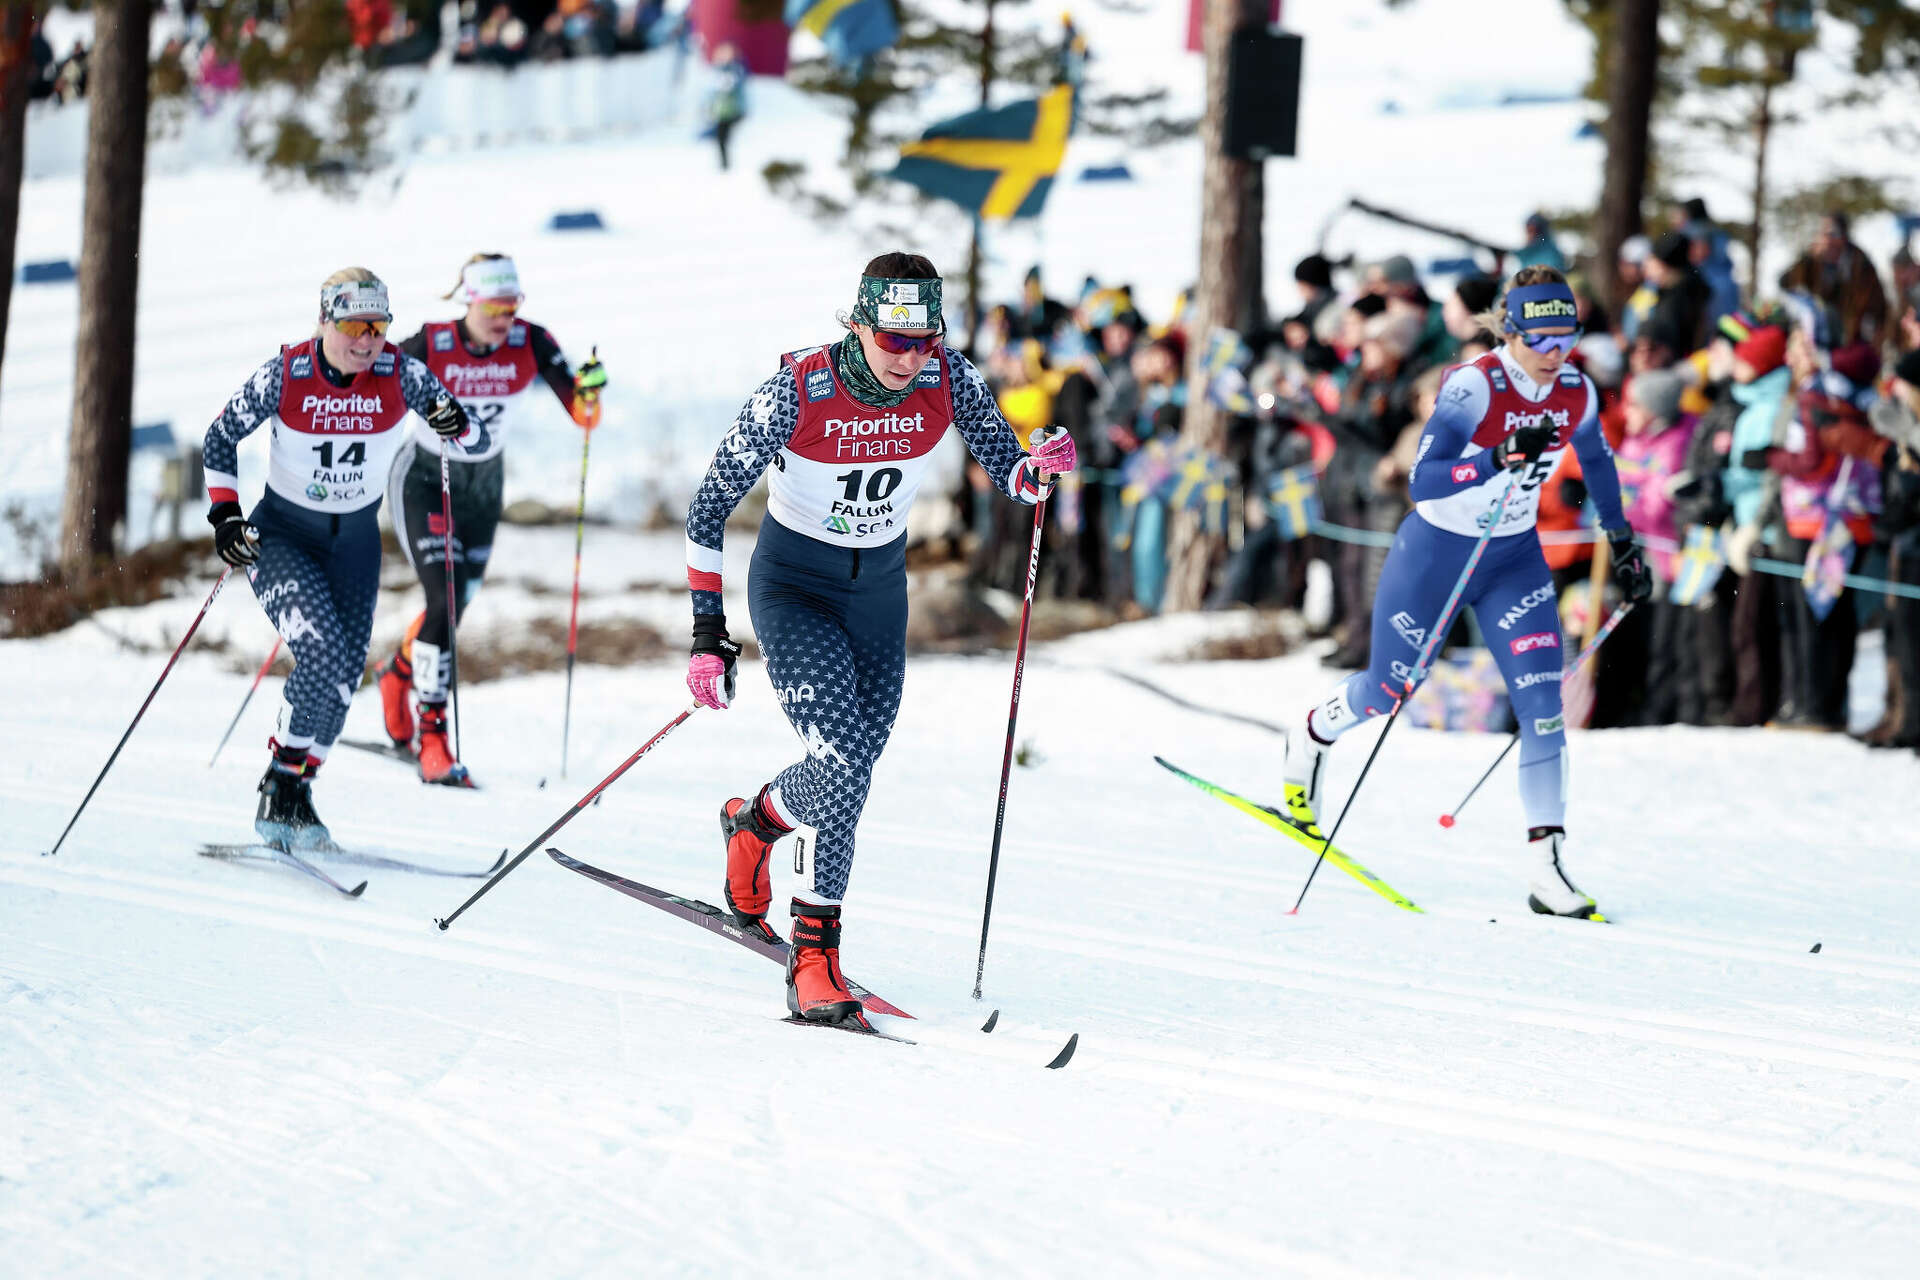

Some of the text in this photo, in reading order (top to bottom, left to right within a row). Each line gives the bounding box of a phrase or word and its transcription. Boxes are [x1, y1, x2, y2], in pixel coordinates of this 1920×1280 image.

[879, 320, 927, 328] Dermatone
[445, 362, 517, 382] Prioritet
[918, 374, 940, 384] oop
[811, 387, 831, 397] coop
[302, 393, 383, 413] Prioritet
[312, 411, 374, 431] Finans
[824, 412, 925, 437] Prioritet
[312, 441, 367, 469] 14
[837, 437, 912, 458] Finans
[313, 470, 363, 483] FALUN
[837, 467, 903, 502] 10
[831, 501, 894, 518] FALUN
[1025, 525, 1042, 607] SWIX
[722, 924, 743, 940] ATOMIC
[795, 932, 821, 941] ATOMIC
